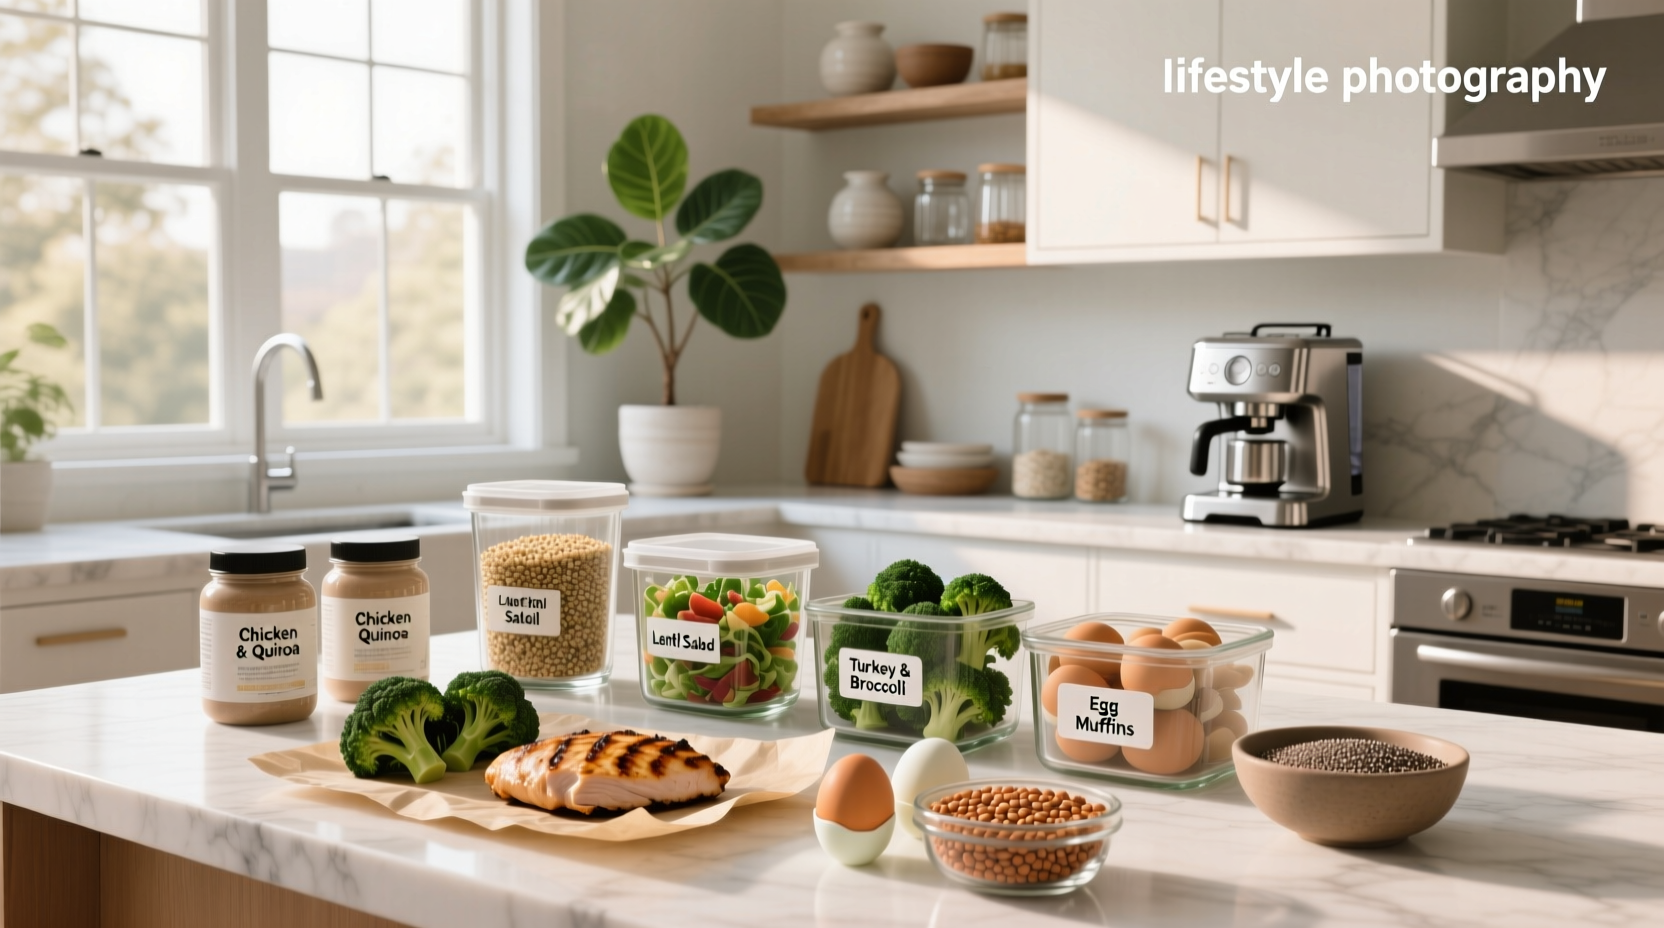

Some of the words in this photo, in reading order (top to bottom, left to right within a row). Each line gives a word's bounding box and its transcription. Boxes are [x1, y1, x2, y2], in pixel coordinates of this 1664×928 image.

[355, 610, 411, 626] Chicken
[239, 625, 298, 642] Chicken
[358, 628, 409, 645] Quinoa
[236, 645, 248, 659] &
[849, 656, 896, 680] Turkey
[900, 662, 911, 678] &
[1090, 695, 1119, 717] Egg
[1075, 715, 1135, 737] Muffins
